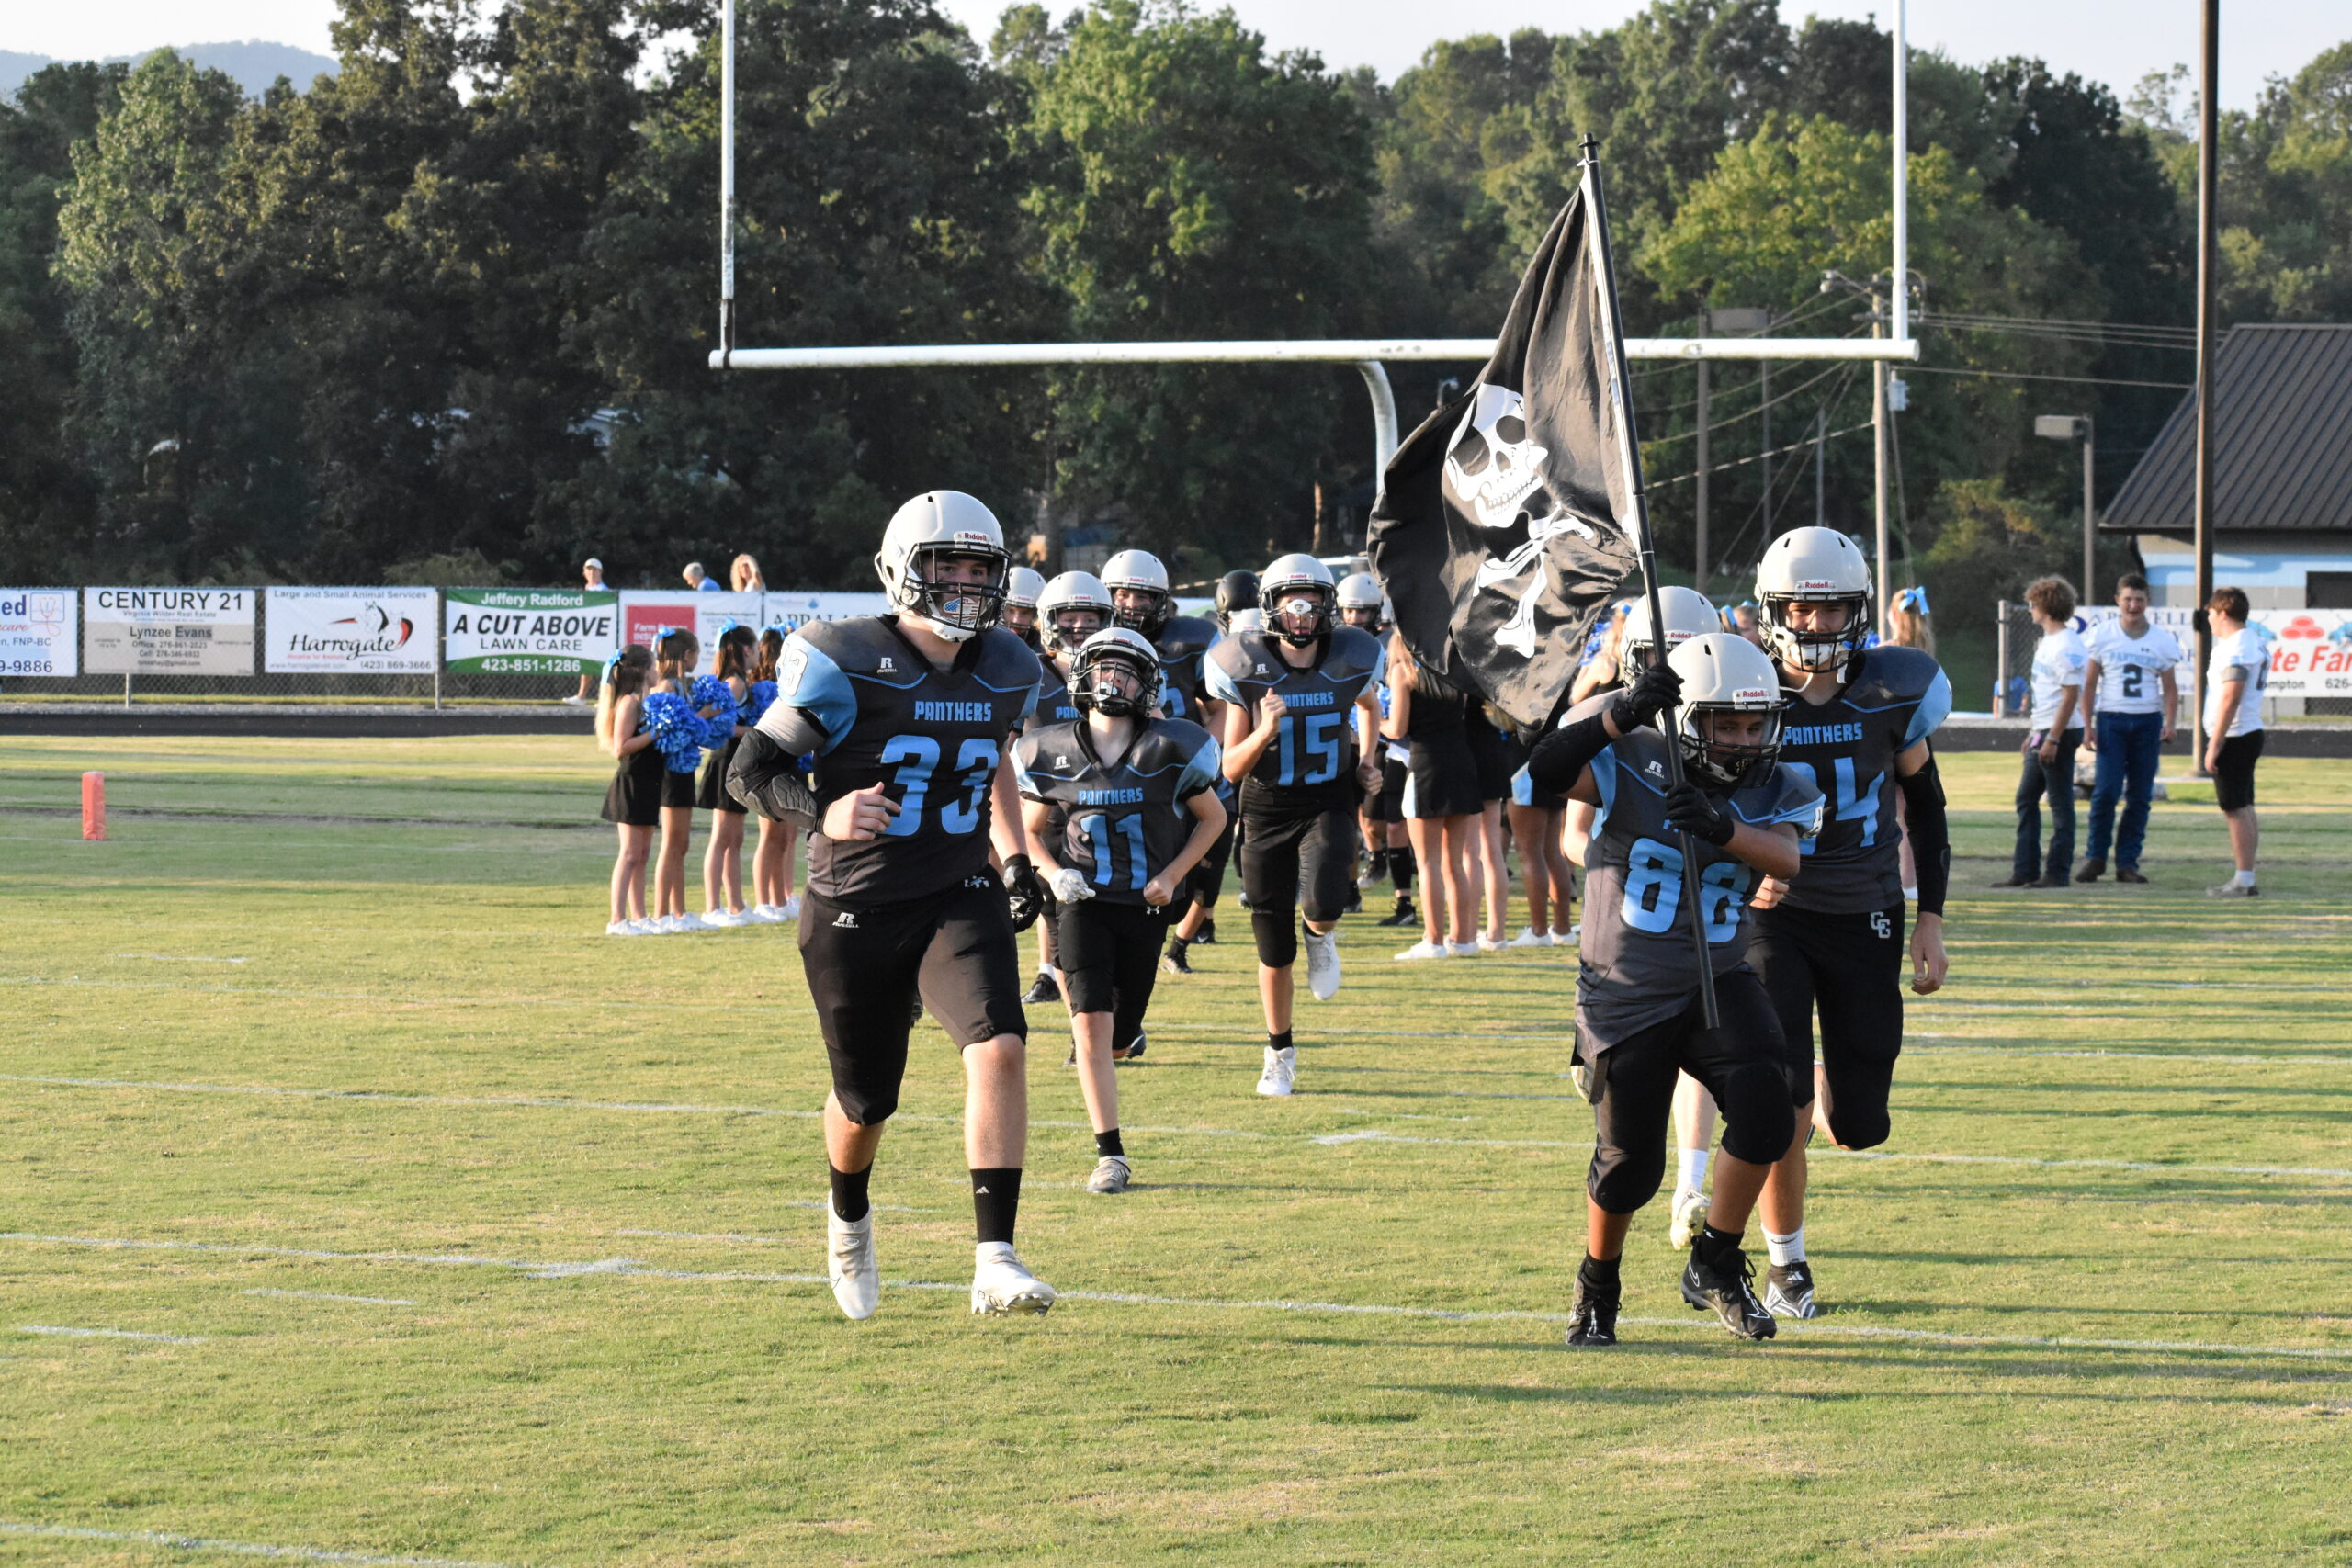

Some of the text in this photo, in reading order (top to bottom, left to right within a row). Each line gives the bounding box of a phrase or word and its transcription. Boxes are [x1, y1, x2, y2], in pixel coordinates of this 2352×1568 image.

[964, 532, 988, 541] Riddell
[98, 591, 243, 611] CENTURY 21
[274, 590, 301, 600] Large
[323, 591, 350, 599] Small
[352, 591, 384, 599] Animal
[387, 591, 427, 599] Services
[481, 592, 583, 607] Jeffery Radford
[123, 609, 151, 618] Virginia
[130, 626, 212, 641] Lynzee Evans
[452, 615, 612, 637] A CUT ABOVE
[13, 637, 51, 647] FNP-BC
[289, 634, 396, 660] Harrogate
[481, 638, 582, 651] LAWN CARE
[360, 660, 384, 670] (423)
[481, 659, 581, 672] 423-851-1286
[2122, 663, 2143, 698] 2
[914, 701, 992, 722] PANTHERS
[1782, 722, 1863, 746] PANTHERS
[1278, 712, 1341, 786] 15
[879, 734, 1000, 837] 33
[1078, 787, 1144, 805] PANTHERS
[1080, 813, 1148, 889] 11
[1621, 837, 1751, 943] 88
